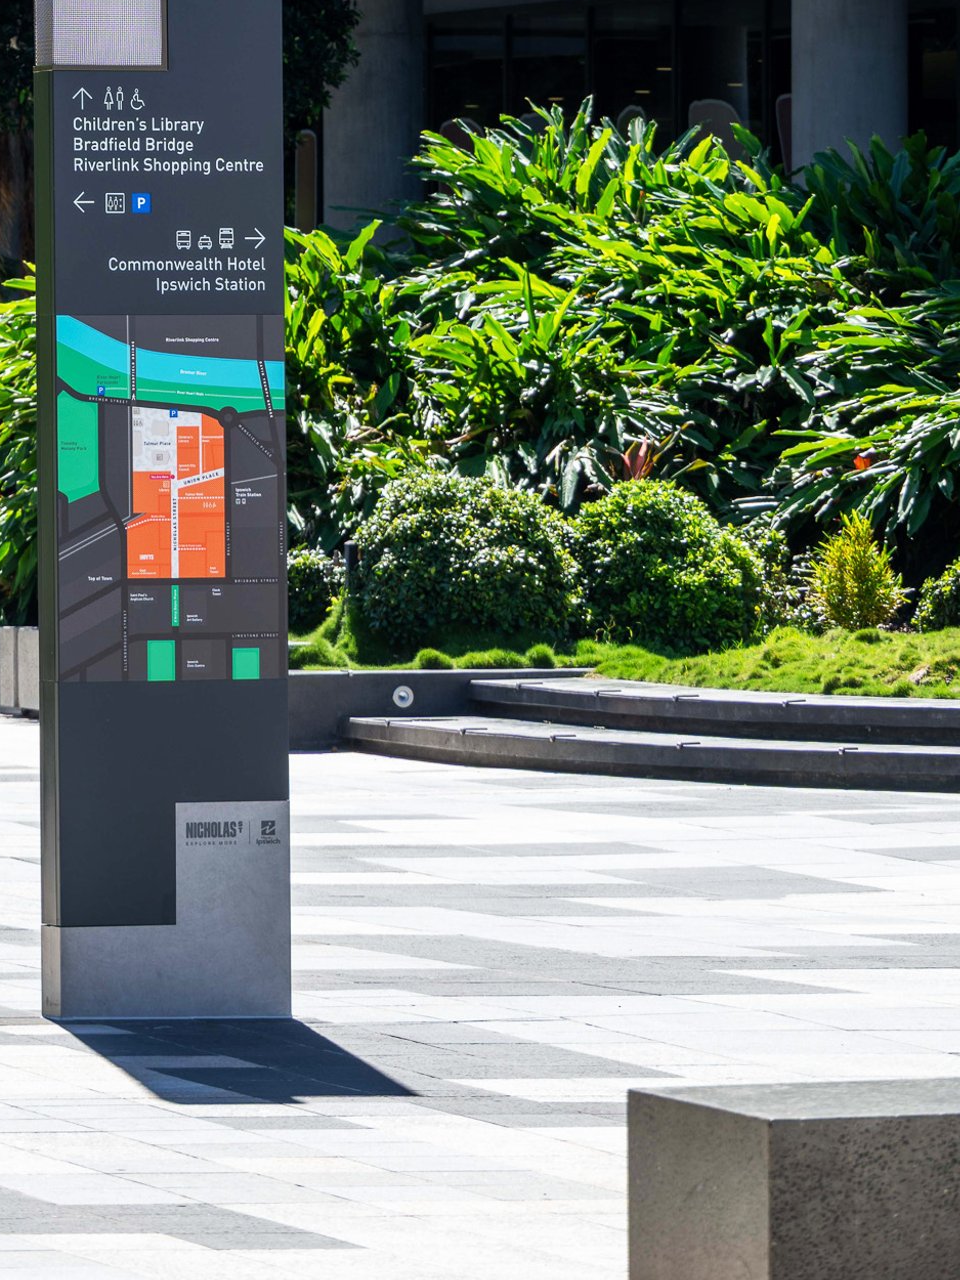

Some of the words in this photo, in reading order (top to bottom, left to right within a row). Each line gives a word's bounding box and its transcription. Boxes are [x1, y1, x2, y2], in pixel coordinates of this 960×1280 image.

[72, 117, 147, 132] Children's
[151, 117, 204, 135] Library
[73, 137, 141, 152] Bradfield
[145, 137, 194, 155] Bridge
[74, 157, 140, 172] Riverlink
[143, 157, 211, 176] Shopping
[215, 157, 264, 172] Centre
[108, 256, 223, 271] Commonwealth
[227, 256, 266, 271] Hotel
[156, 277, 211, 295] Ipswich
[214, 277, 266, 291] Station
[183, 477, 200, 485] UNION
[201, 471, 219, 480] PLACE
[186, 821, 237, 839] NICHOLAS
